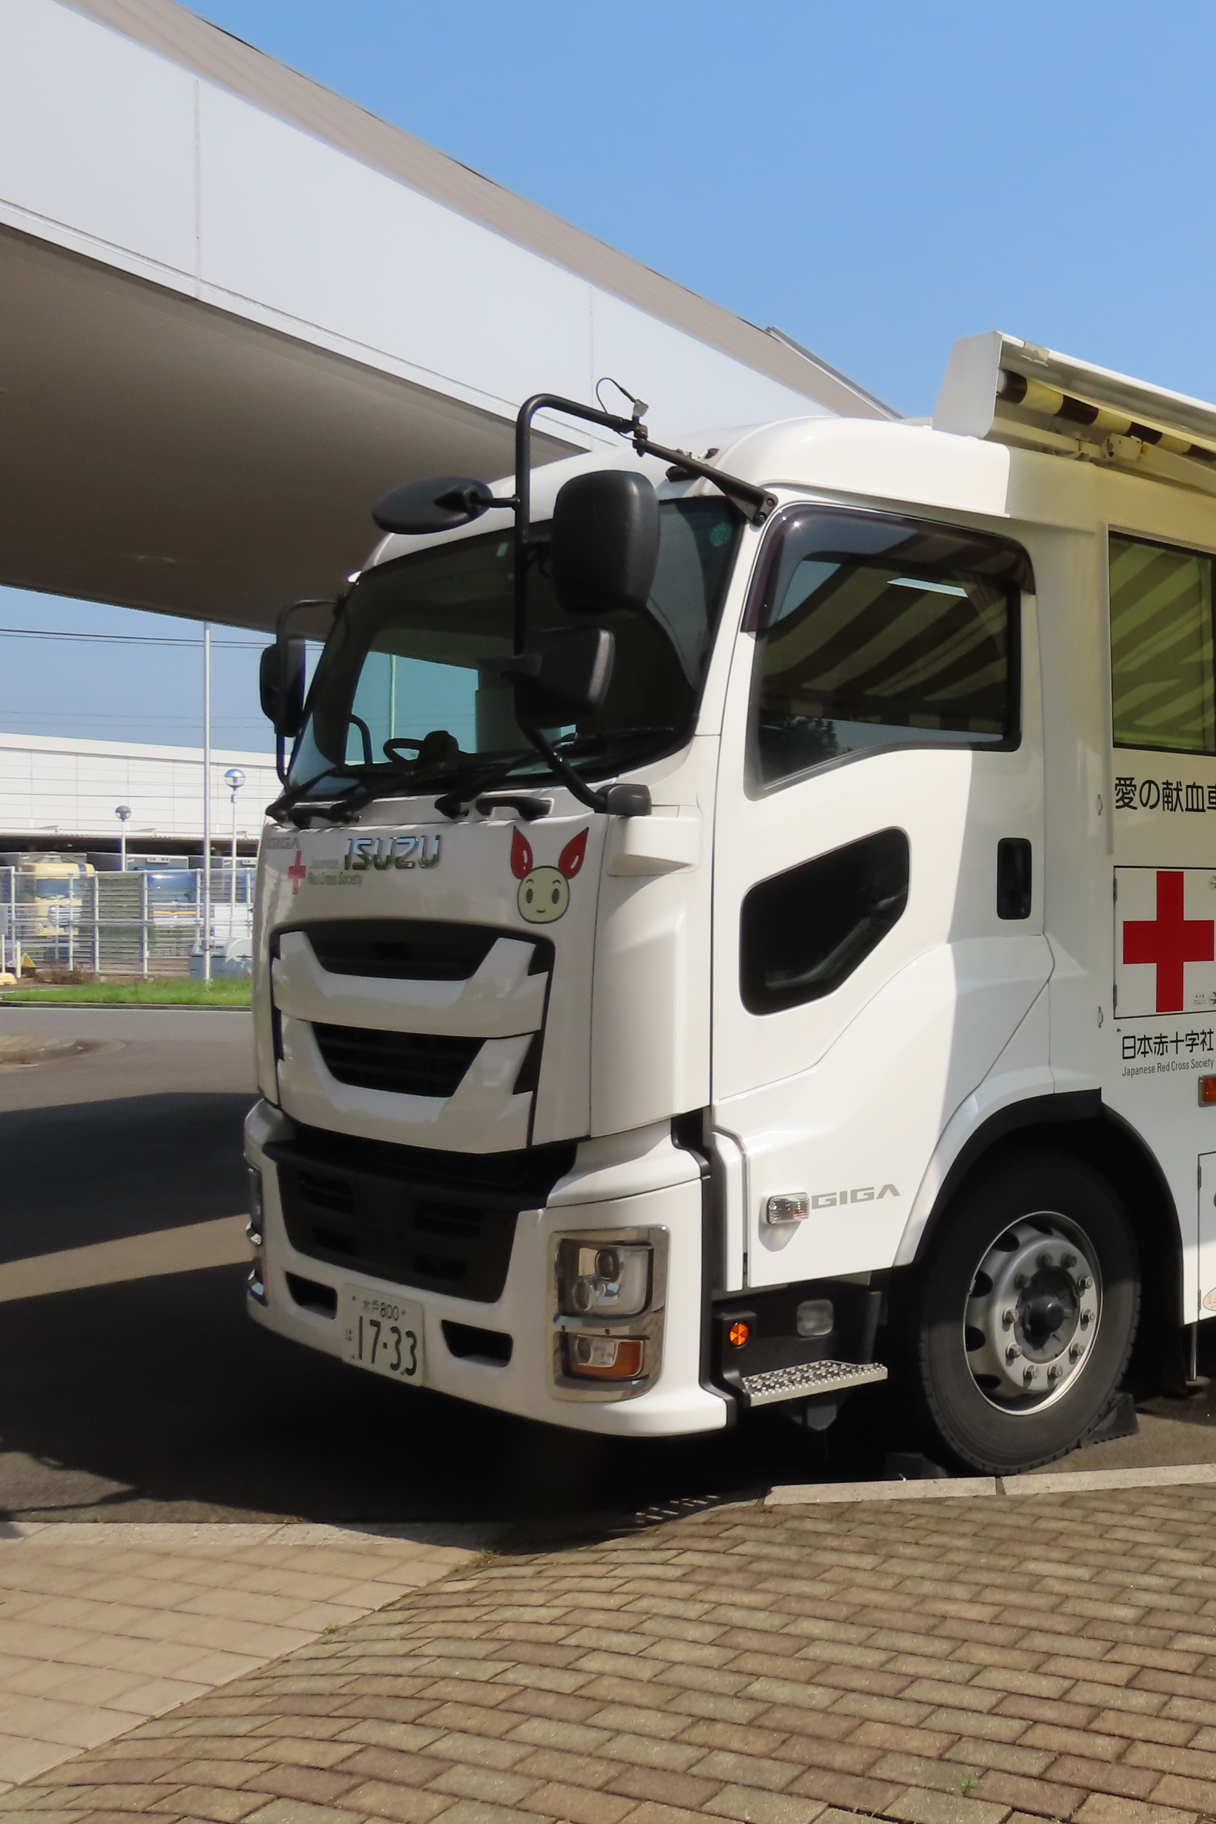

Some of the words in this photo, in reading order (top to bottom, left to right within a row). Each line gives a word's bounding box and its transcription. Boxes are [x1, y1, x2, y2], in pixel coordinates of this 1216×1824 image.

[344, 834, 441, 871] ISUZU
[1122, 1028, 1214, 1060] 日本赤十字社
[1122, 1065, 1156, 1078] Japanese
[1157, 1061, 1170, 1073] Red
[1171, 1060, 1190, 1072] Cross
[1190, 1057, 1215, 1069] Society
[811, 1183, 901, 1210] GIGA
